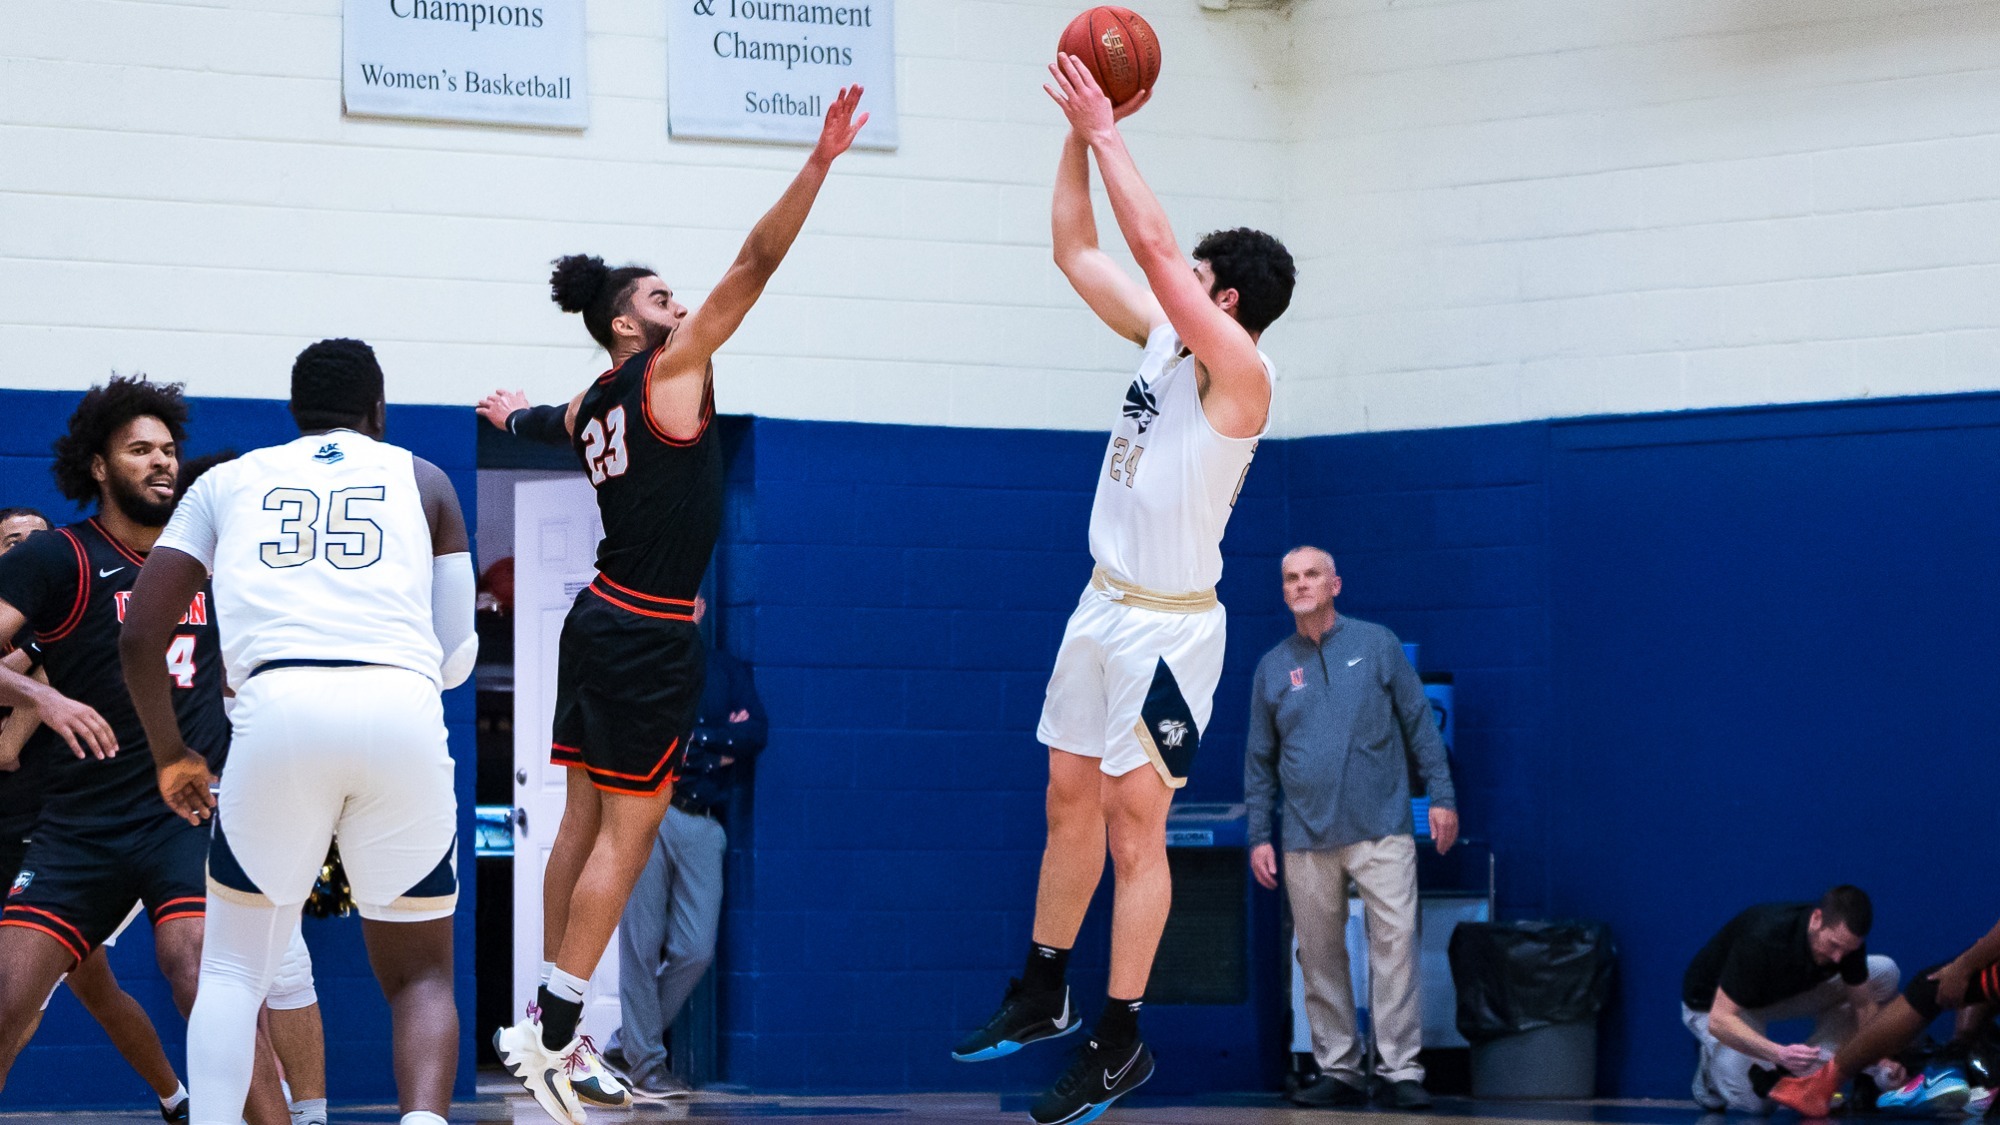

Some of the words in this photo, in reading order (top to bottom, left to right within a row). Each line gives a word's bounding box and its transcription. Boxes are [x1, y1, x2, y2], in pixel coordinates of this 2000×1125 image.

[390, 0, 545, 31] Champions
[693, 0, 716, 17] &
[713, 31, 853, 70] Champions
[361, 63, 458, 93] Women’s
[465, 71, 572, 100] Basketball
[745, 91, 822, 118] Softball
[580, 404, 629, 486] 23
[1109, 436, 1145, 488] 24
[259, 485, 386, 570] 35
